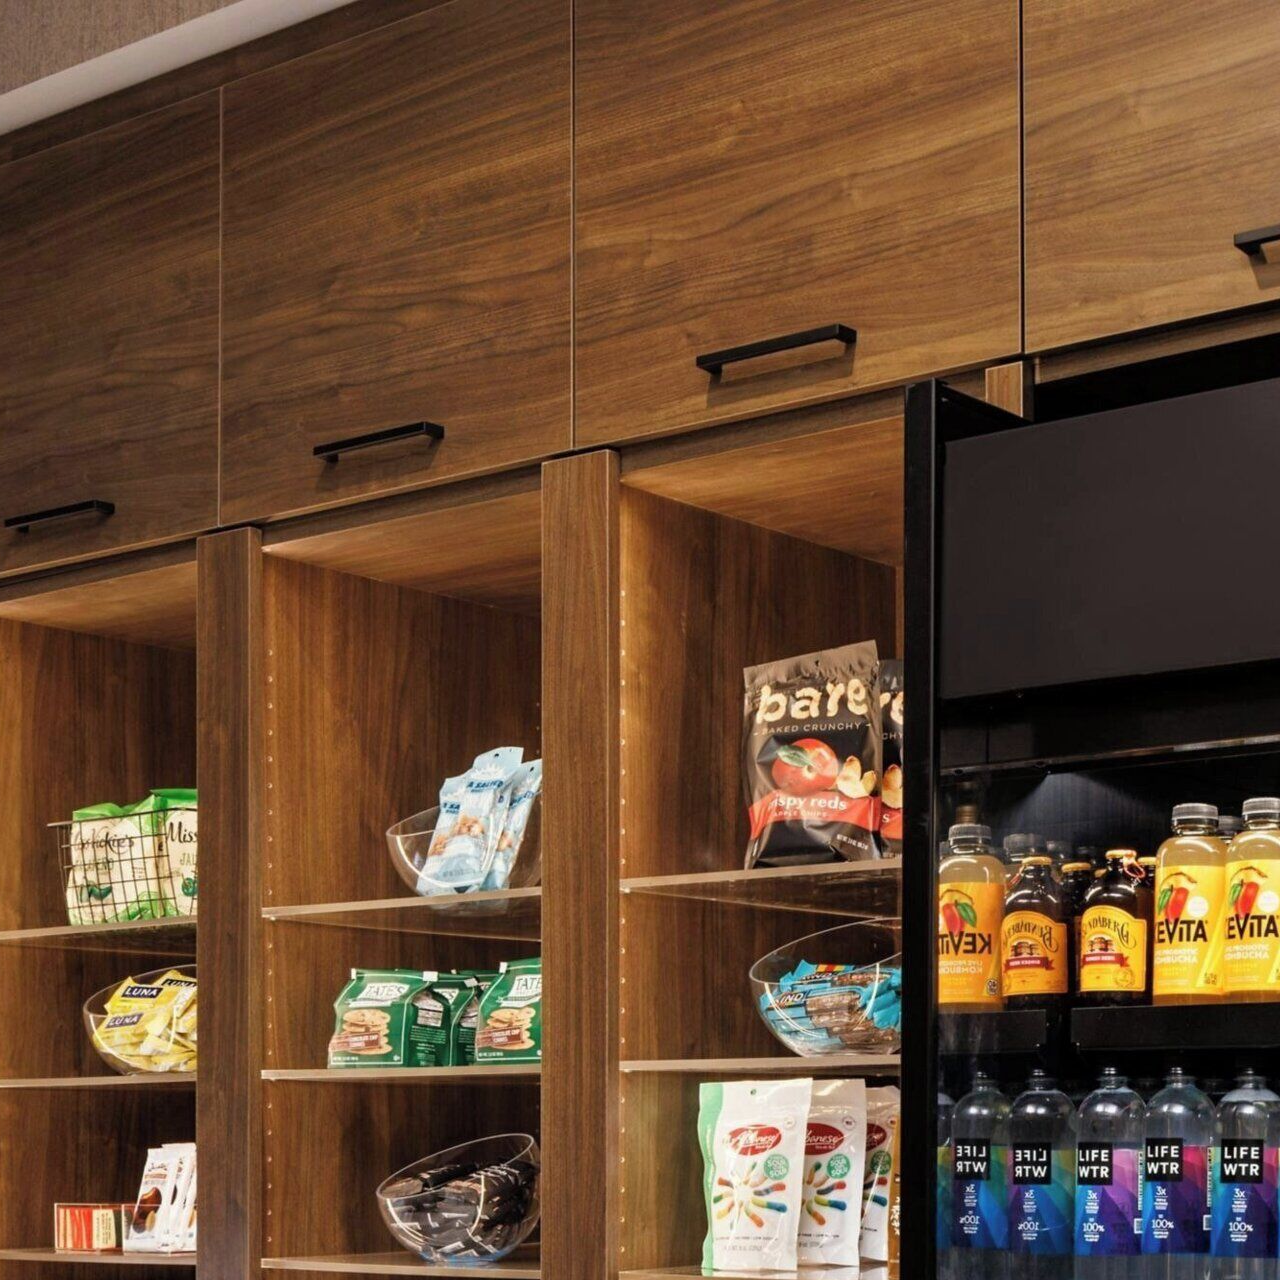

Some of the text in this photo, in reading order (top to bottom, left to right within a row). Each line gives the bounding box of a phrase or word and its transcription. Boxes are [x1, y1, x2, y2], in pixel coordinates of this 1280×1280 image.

[756, 678, 869, 725] bare
[762, 722, 862, 736] BAKED CRUNCHY
[810, 795, 848, 811] reds
[773, 809, 798, 817] APPLE
[166, 980, 196, 988] LUNA
[125, 987, 158, 996] LUNA
[363, 984, 405, 997] TATE'S
[109, 1015, 138, 1026] LUNA
[1078, 1150, 1109, 1162] LIFE
[1147, 1146, 1179, 1158] LIFE
[1224, 1147, 1260, 1159] LIFE
[1078, 1166, 1109, 1178] WTR
[1147, 1162, 1179, 1174] WTR
[1223, 1163, 1260, 1176] WTR
